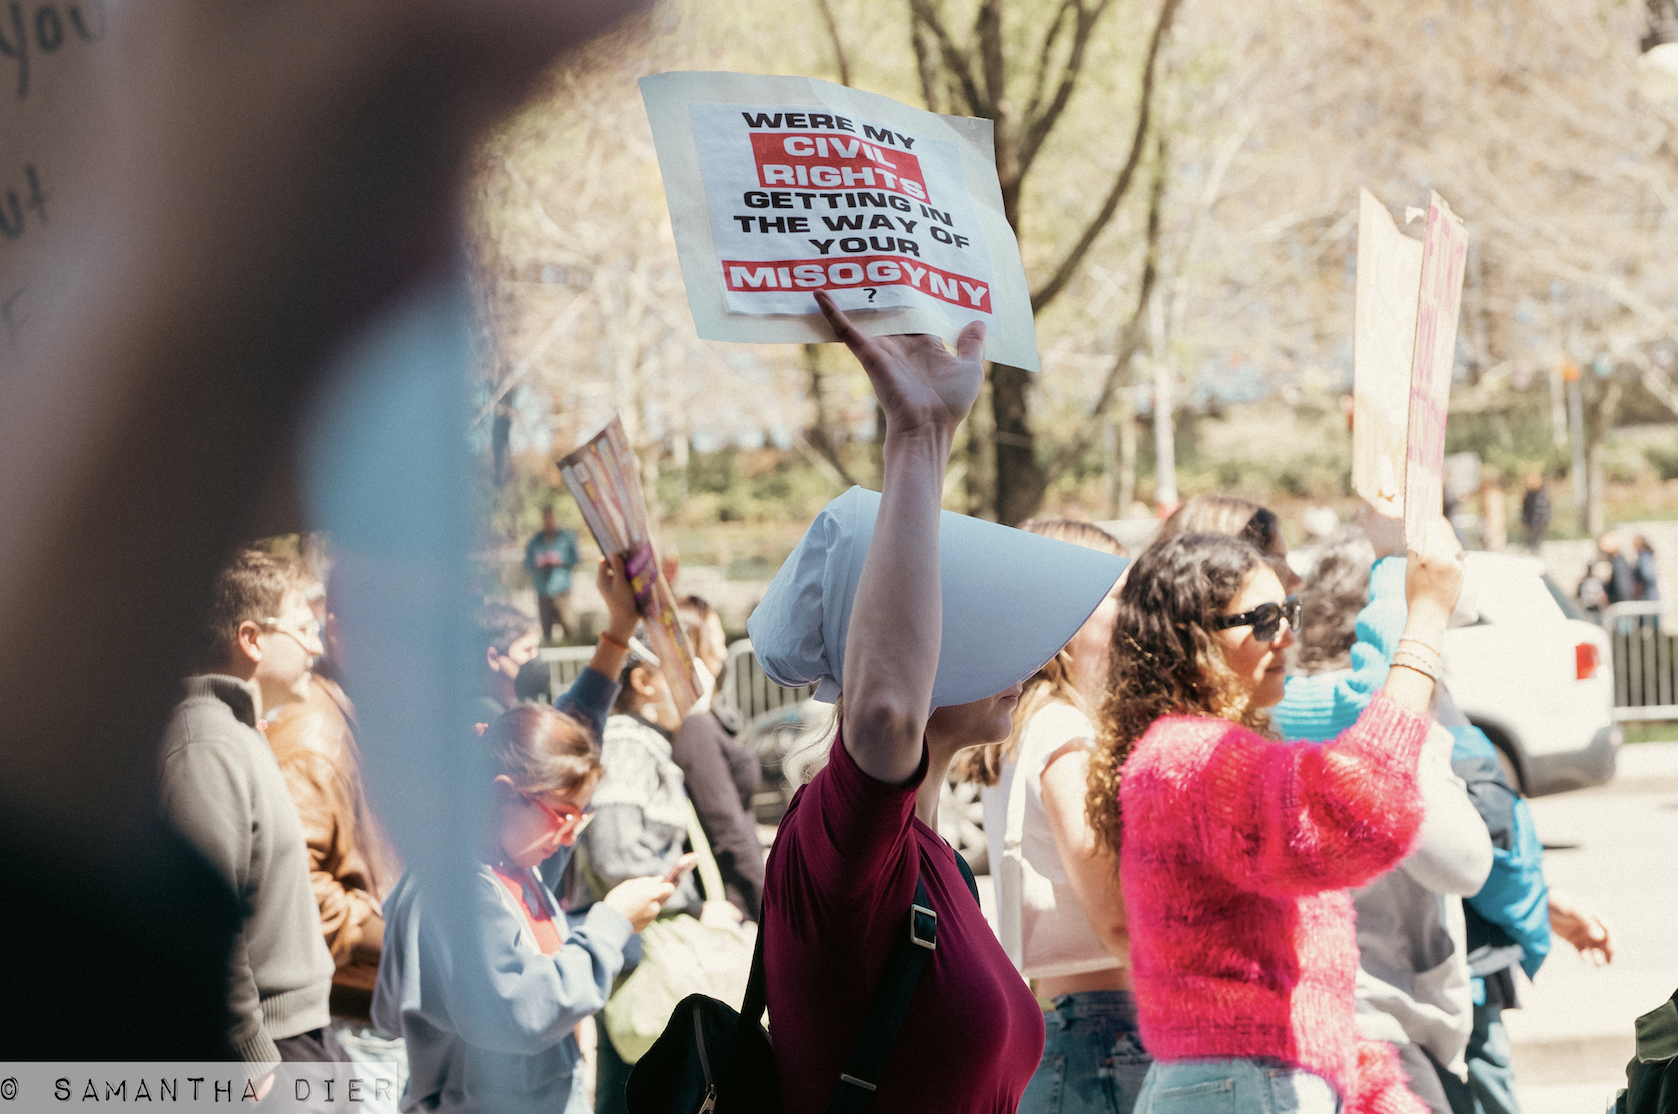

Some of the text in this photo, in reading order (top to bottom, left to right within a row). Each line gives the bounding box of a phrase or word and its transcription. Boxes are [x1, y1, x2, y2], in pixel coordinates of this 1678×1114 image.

[741, 112, 916, 150] WERE MY
[783, 136, 897, 169] CIVIL
[760, 164, 927, 200] RIGHTS
[743, 191, 954, 227] GETTING IN
[733, 214, 970, 249] THE WAY OF
[809, 236, 920, 257] YOUR
[728, 260, 987, 307] MISOGYNY
[863, 288, 877, 303] ?
